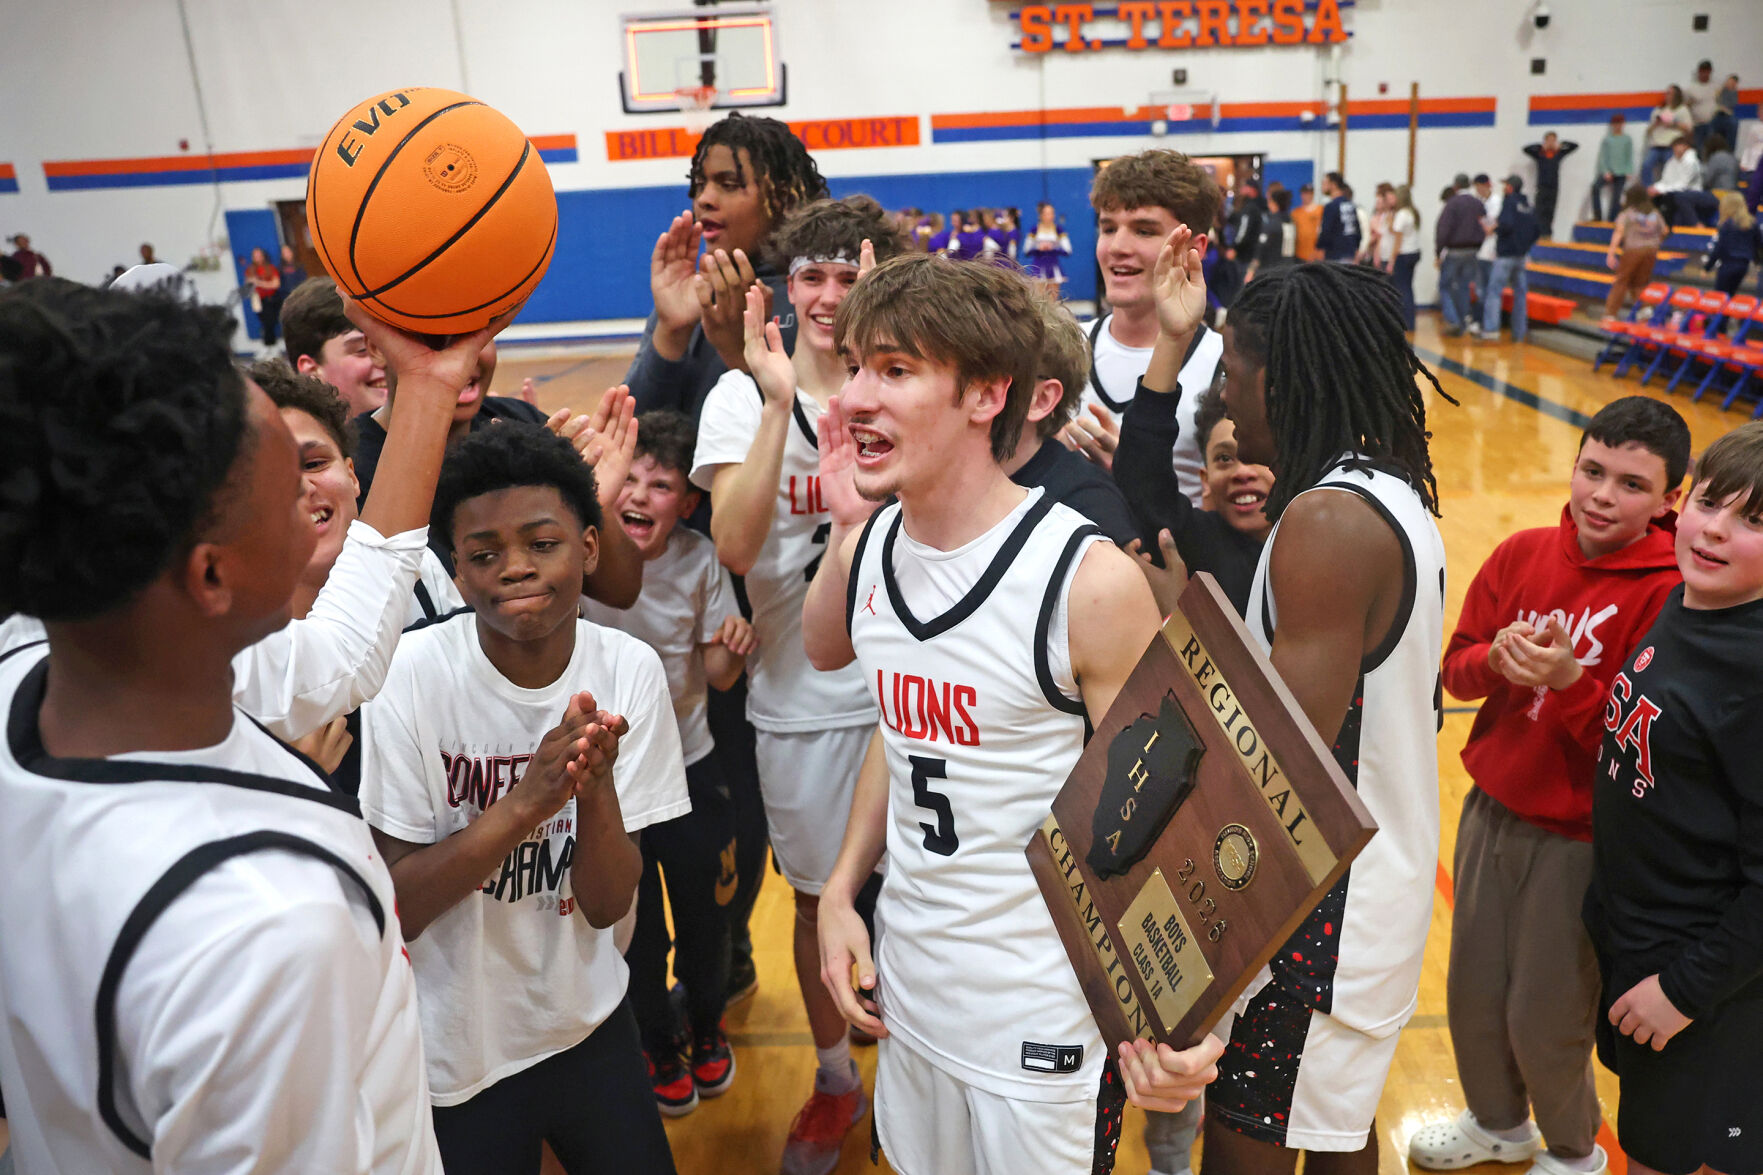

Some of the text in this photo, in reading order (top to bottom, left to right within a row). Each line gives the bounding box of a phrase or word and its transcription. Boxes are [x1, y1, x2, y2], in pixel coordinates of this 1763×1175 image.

[1020, 0, 1349, 52] ST. TERESA
[337, 92, 411, 167] EVO
[617, 118, 907, 159] BILL COURT
[877, 669, 981, 747] LIONS
[1180, 633, 1308, 846] REGIONAL
[1604, 671, 1662, 789] SA
[529, 818, 572, 841] ISTIAN
[908, 754, 960, 857] 5
[1141, 911, 1183, 992] BASKETBALL
[1164, 914, 1187, 953] BOYS
[1133, 942, 1165, 1001] CLASS 1A
[1063, 1054, 1075, 1066] M
